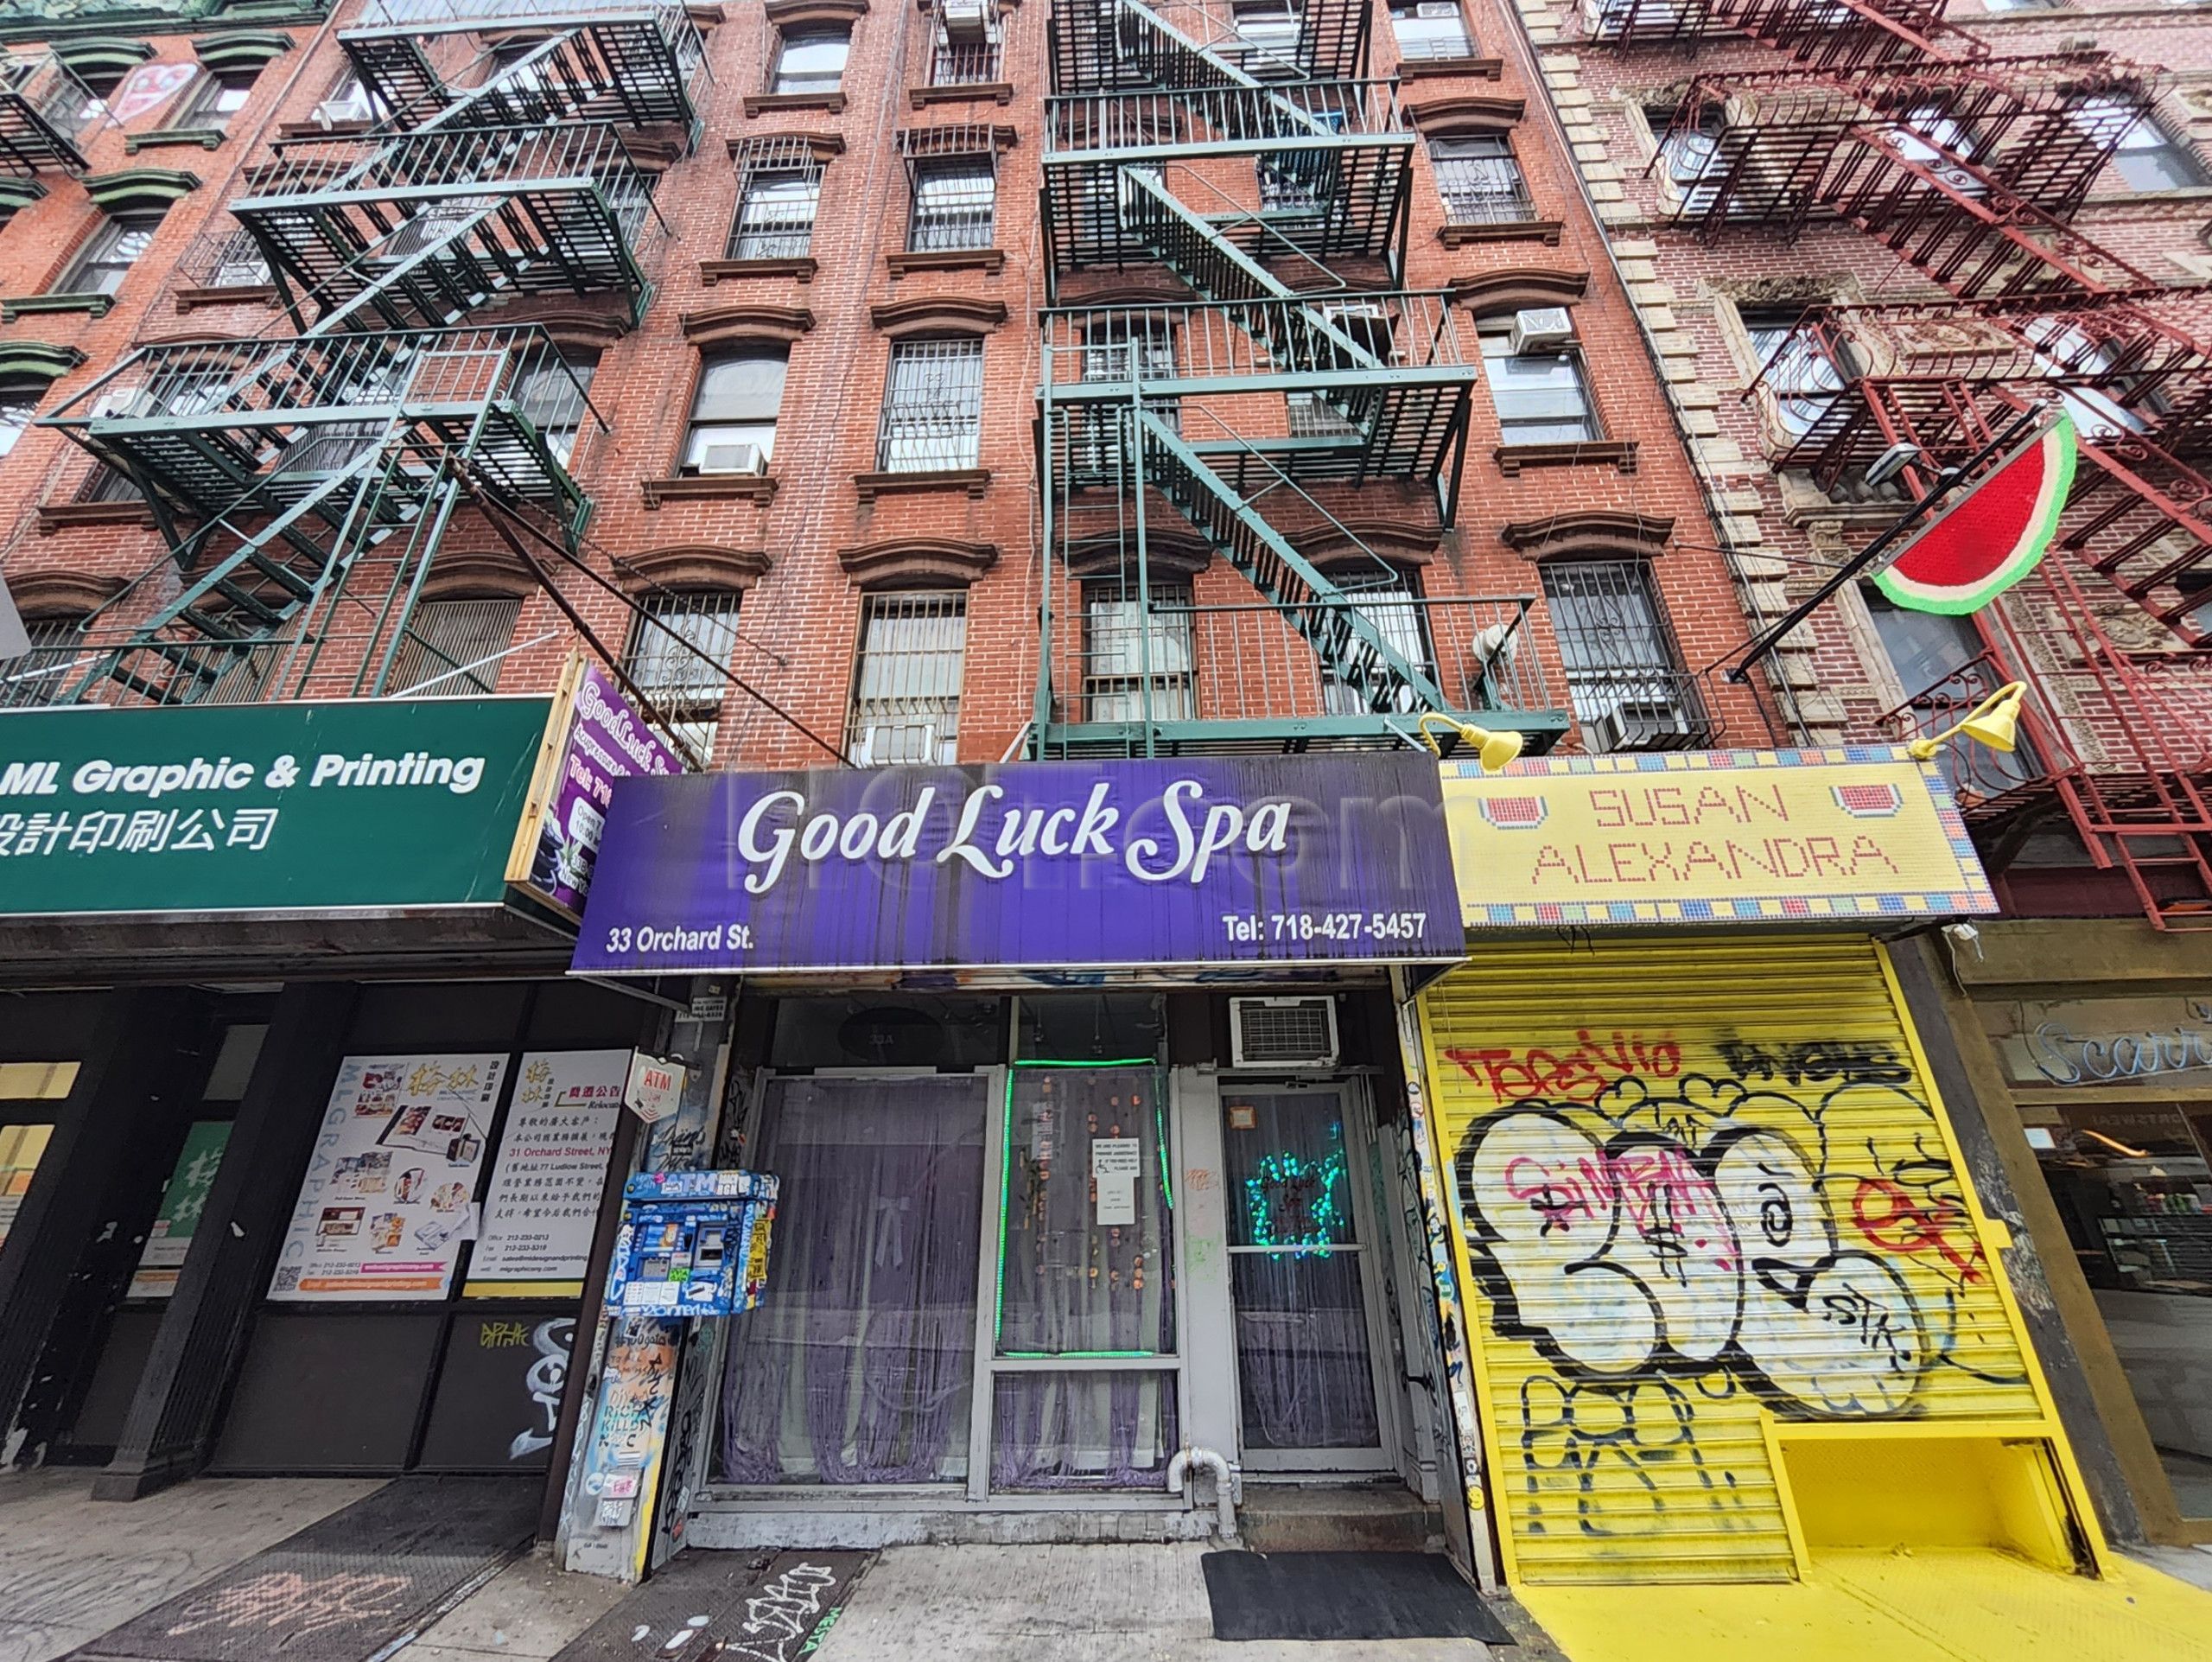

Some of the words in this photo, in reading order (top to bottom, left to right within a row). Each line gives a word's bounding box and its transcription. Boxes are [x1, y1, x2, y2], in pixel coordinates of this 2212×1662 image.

[0, 761, 59, 795] ML
[72, 755, 255, 799] Graphic
[264, 755, 301, 789] &
[309, 750, 486, 793] Printing
[1588, 783, 1790, 828] SUSAN
[738, 786, 936, 894] Good
[937, 782, 1120, 879] Luck
[1125, 780, 1293, 884] Spa
[1530, 834, 1899, 885] ALEXANDRA
[605, 927, 632, 953] 33
[635, 924, 721, 952] Orchard
[725, 923, 754, 951] St.
[1222, 914, 1264, 943] Tel:
[1271, 912, 1427, 941] 718-427-5457
[644, 1068, 673, 1092] ATM
[509, 1149, 520, 1157] 31
[524, 1147, 562, 1157] Orchard
